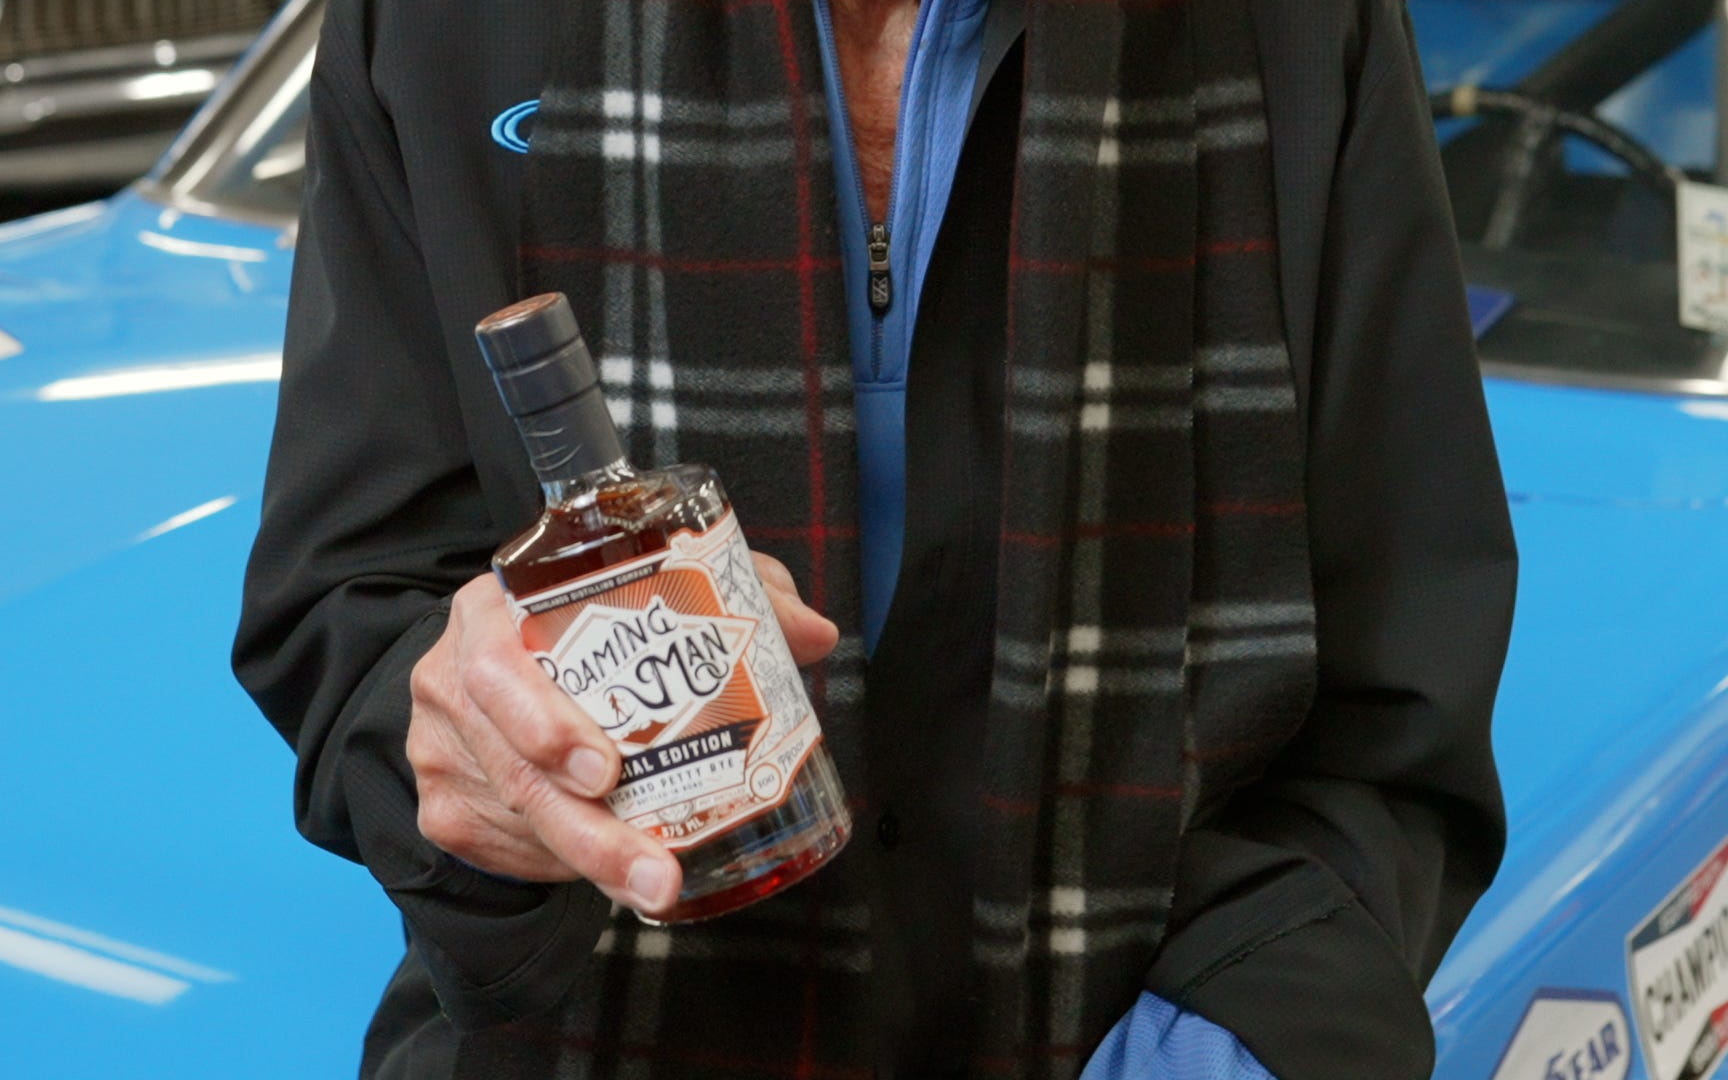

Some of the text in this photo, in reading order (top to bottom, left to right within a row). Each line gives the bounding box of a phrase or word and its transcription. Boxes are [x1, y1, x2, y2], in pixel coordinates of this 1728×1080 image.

[615, 565, 653, 587] COMPANY
[612, 622, 730, 710] MAN
[658, 730, 733, 768] EDITION
[660, 768, 702, 788] PETTY
[709, 758, 734, 774] RYE
